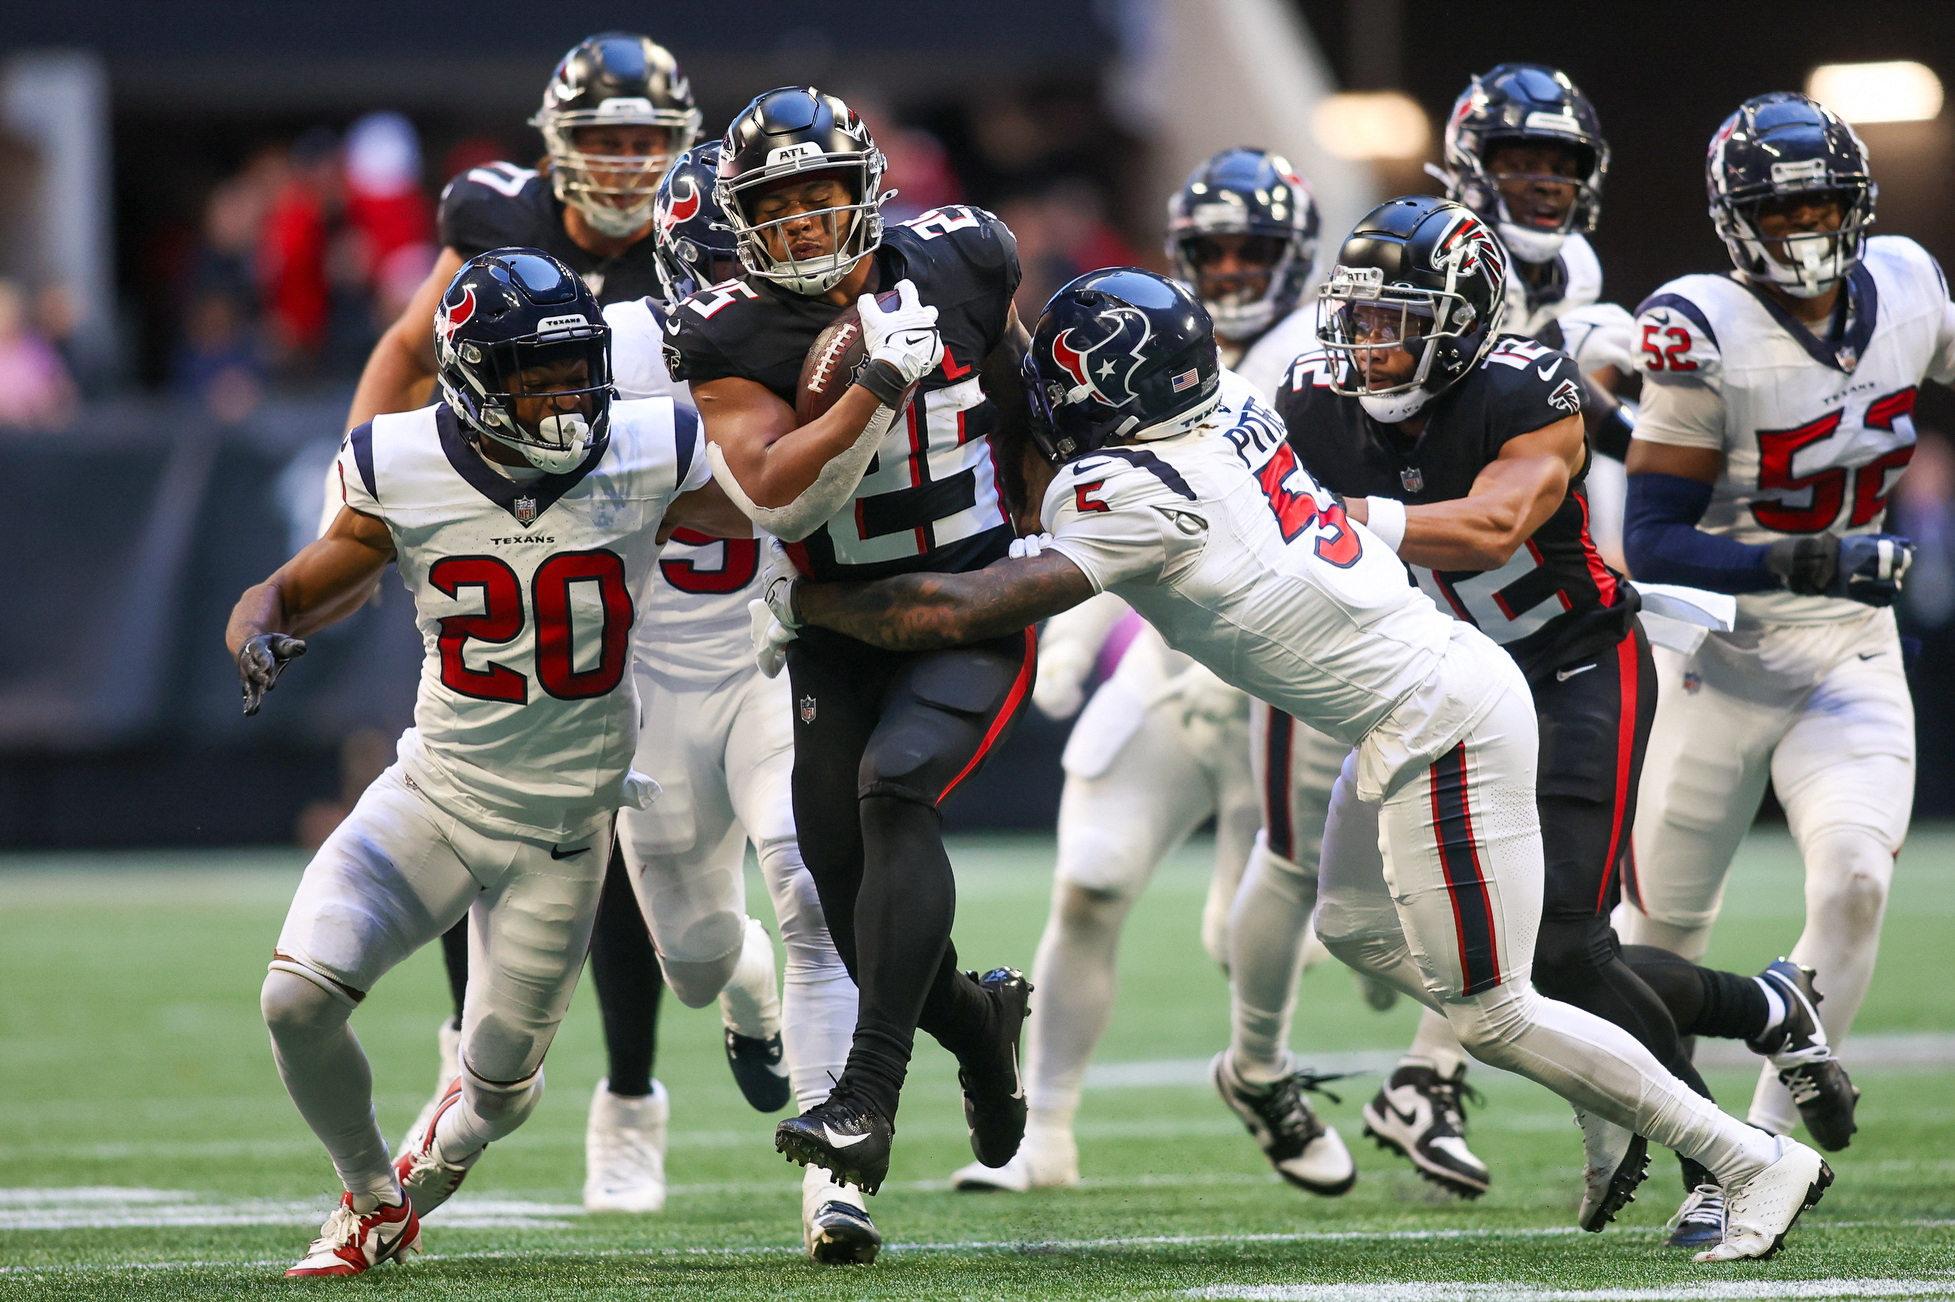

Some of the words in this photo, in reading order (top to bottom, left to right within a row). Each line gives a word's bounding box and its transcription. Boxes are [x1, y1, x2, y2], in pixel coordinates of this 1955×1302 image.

[779, 147, 808, 160] ATL
[1347, 272, 1368, 281] ATL
[546, 317, 581, 326] TEXANS
[1641, 325, 1698, 371] 52
[1748, 385, 1917, 535] 52
[1252, 439, 1363, 570] 5
[490, 535, 556, 546] TEXANS
[429, 548, 635, 706] 20
